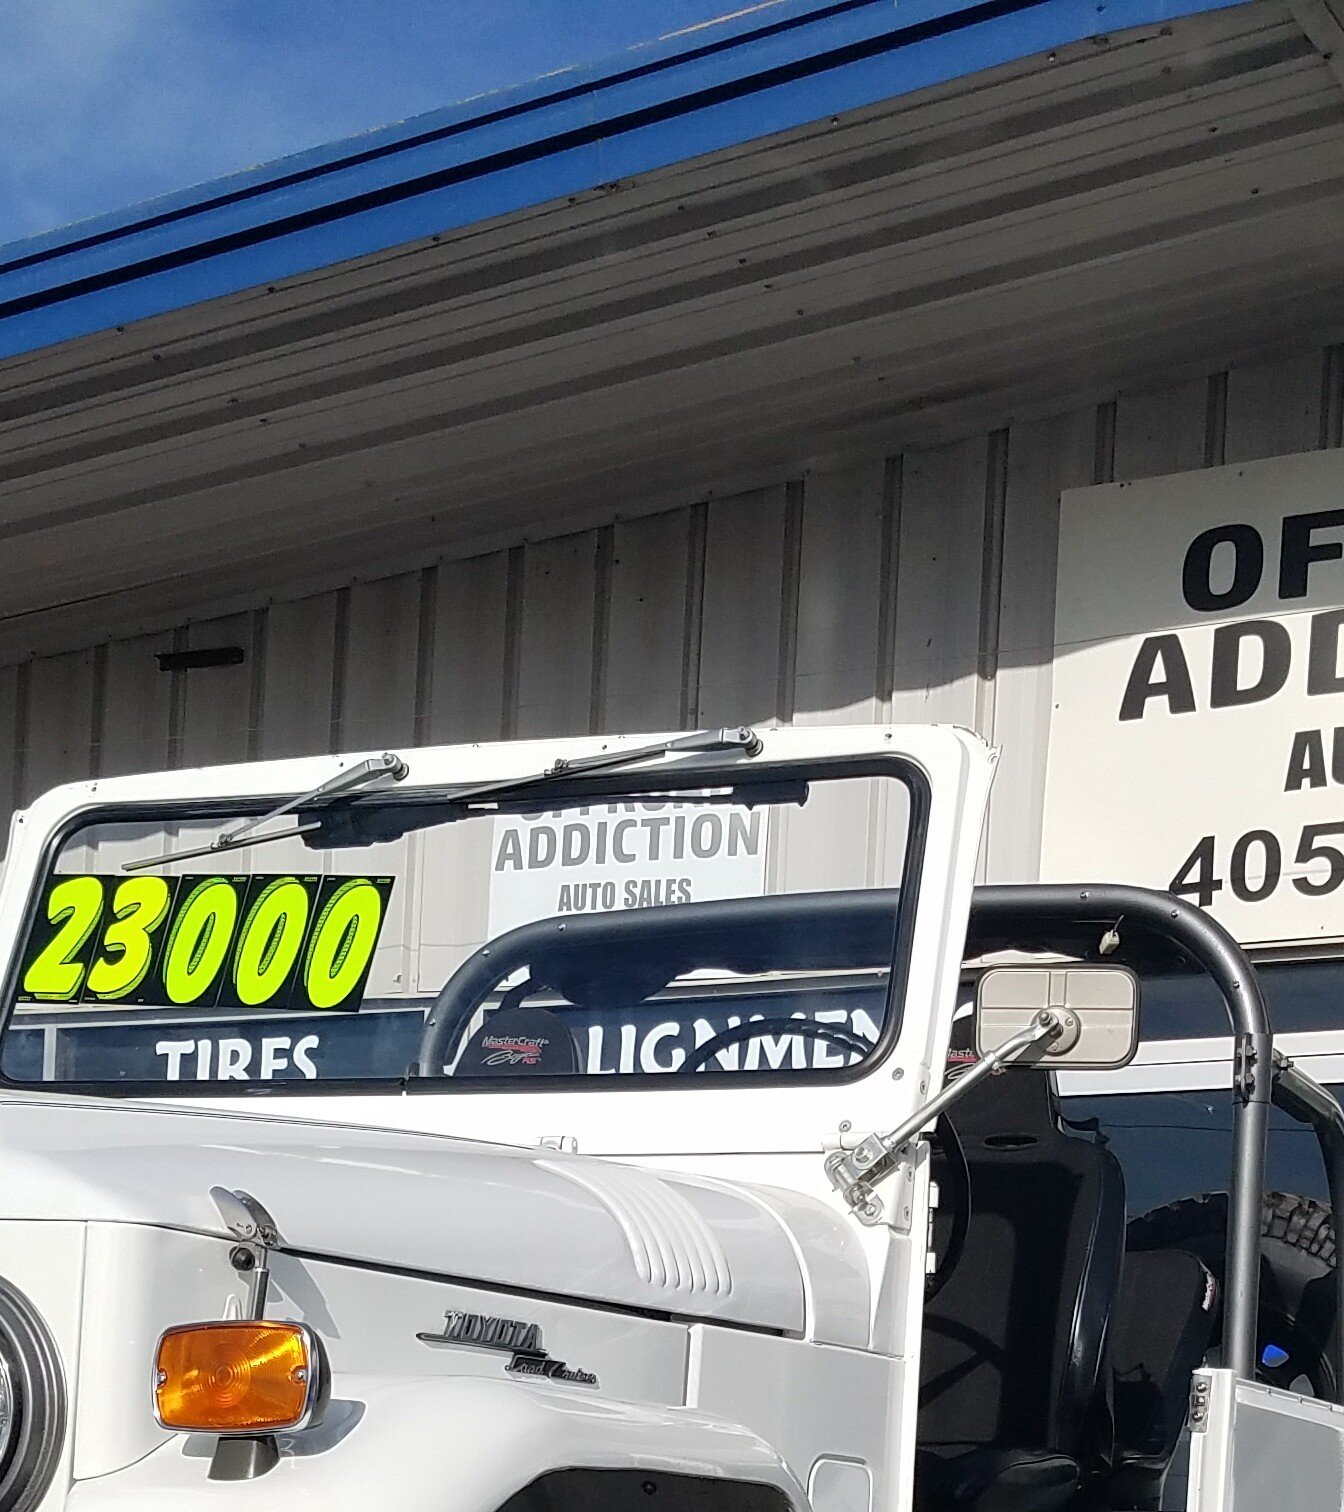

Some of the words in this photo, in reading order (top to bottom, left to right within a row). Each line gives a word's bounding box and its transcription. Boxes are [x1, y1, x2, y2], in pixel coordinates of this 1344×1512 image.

[495, 811, 761, 873] ADDICTION
[557, 881, 616, 912] AUTO
[624, 878, 692, 908] SALES
[23, 876, 381, 1008] 23000
[155, 1035, 320, 1081] TIRES
[444, 1310, 544, 1350] TOYOTA
